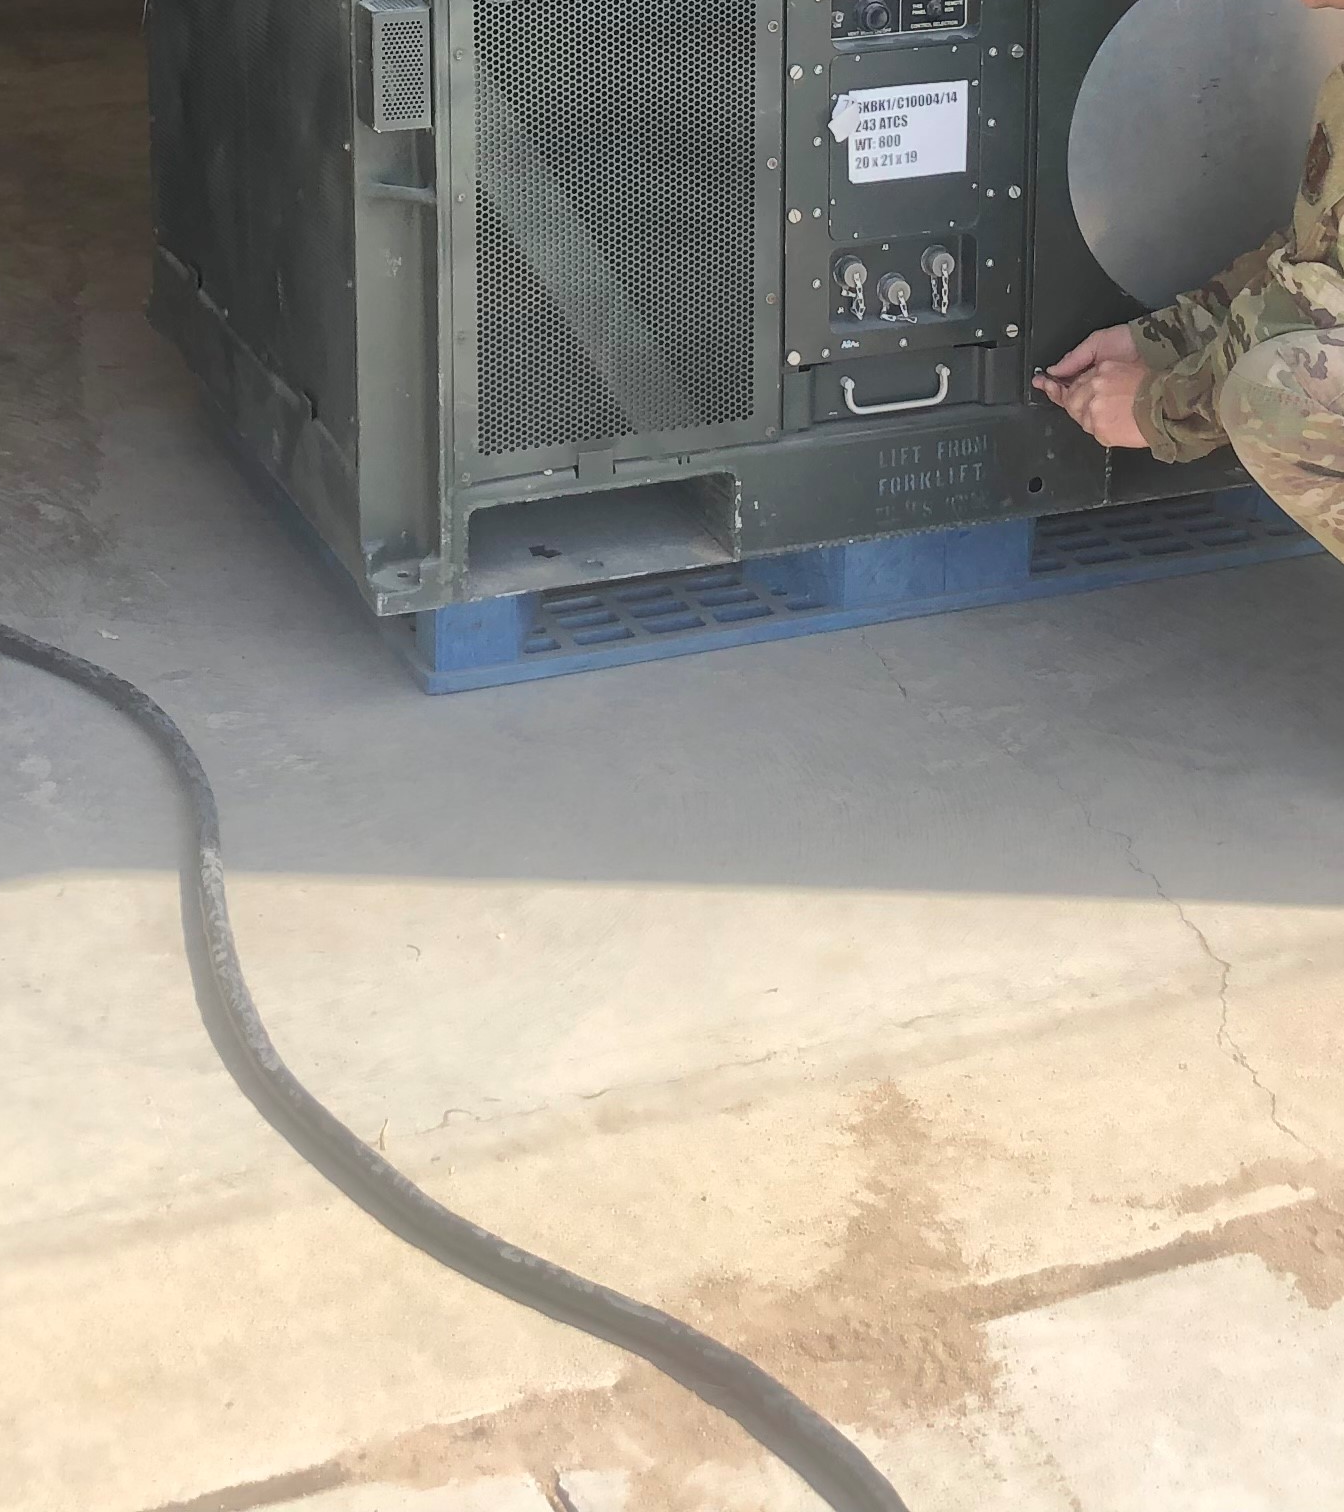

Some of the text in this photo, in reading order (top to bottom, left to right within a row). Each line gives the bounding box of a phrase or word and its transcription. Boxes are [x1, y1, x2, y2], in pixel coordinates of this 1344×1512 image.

[855, 114, 909, 133] 243 ATCS
[855, 138, 876, 152] WT:
[855, 156, 870, 170] 20
[881, 153, 894, 167] 21
[905, 150, 918, 164] 19
[879, 434, 987, 468] LIFT FROM
[878, 462, 983, 497] FORKLIFT
